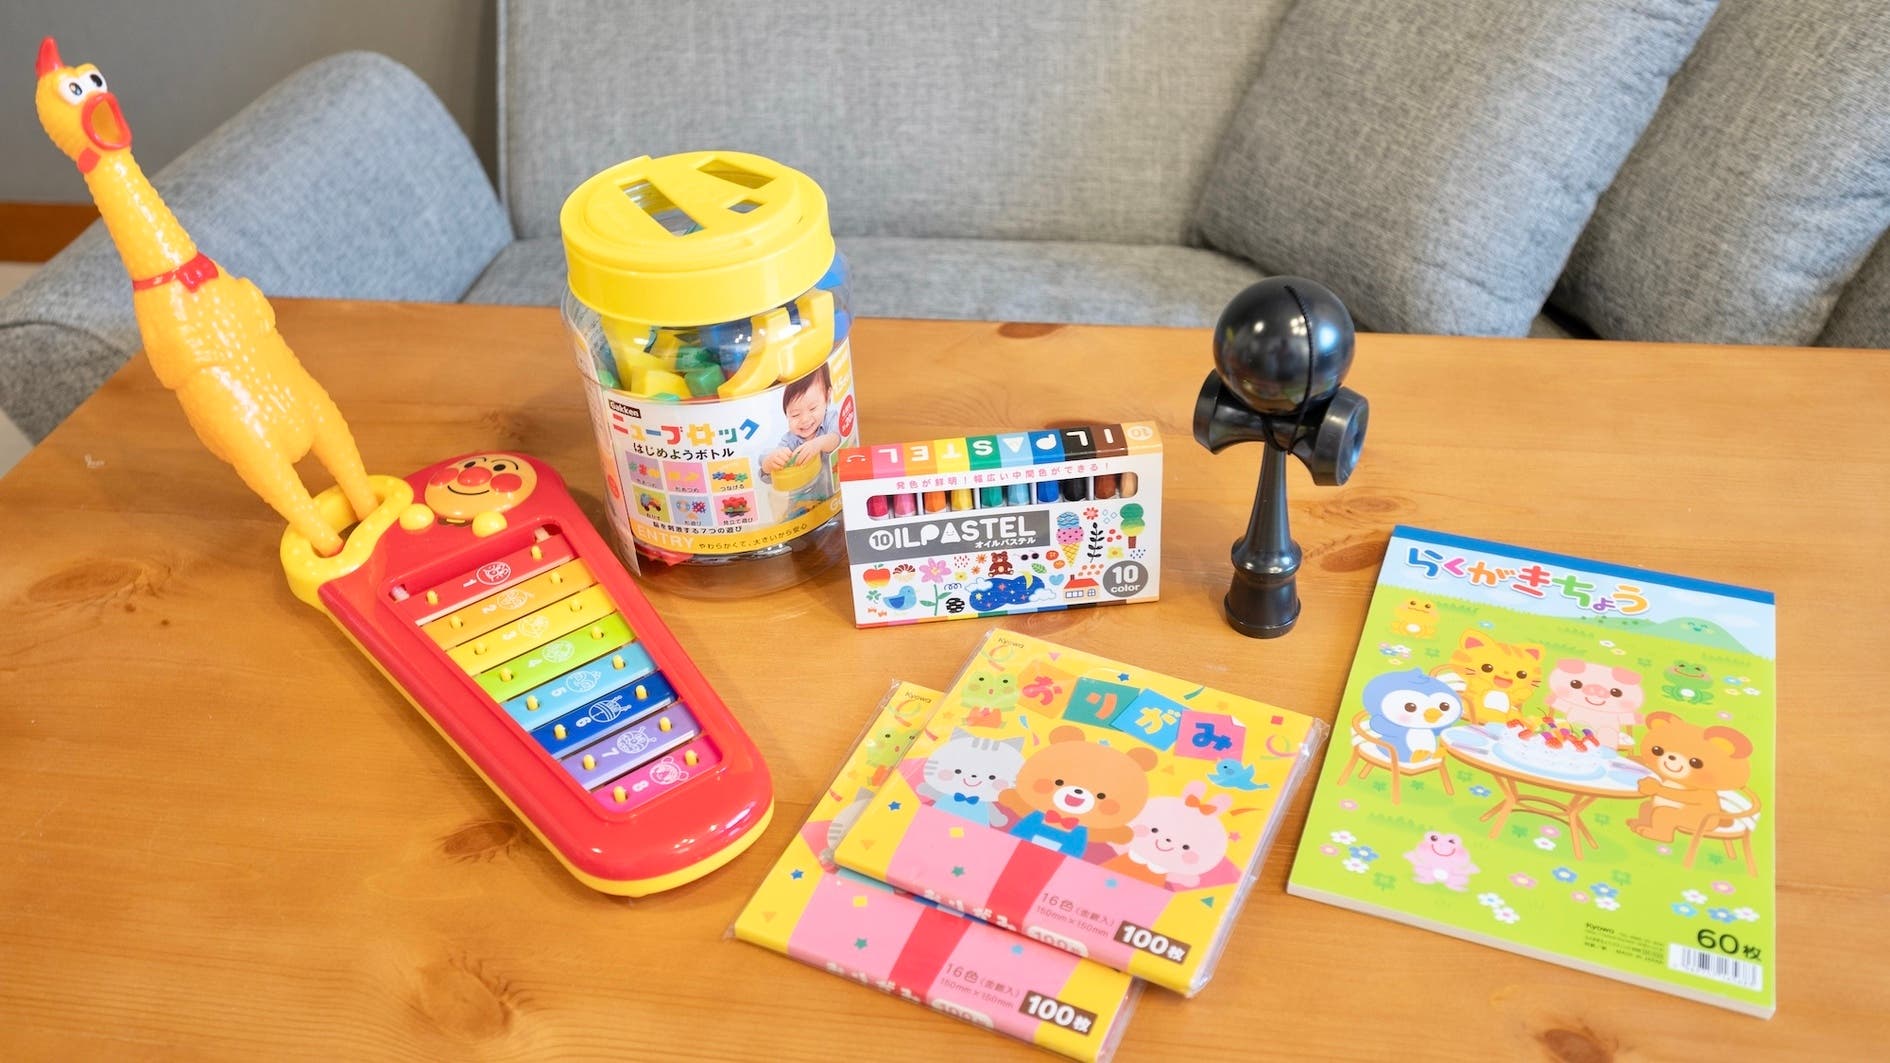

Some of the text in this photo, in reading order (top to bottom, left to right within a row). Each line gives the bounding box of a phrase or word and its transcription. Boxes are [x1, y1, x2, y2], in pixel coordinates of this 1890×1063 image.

[612, 413, 760, 447] ニューブロック
[633, 442, 735, 461] はじめようボトル
[638, 523, 695, 549] ENTRY
[975, 536, 1037, 549] オイルパステル
[1110, 582, 1141, 593] color
[1111, 565, 1140, 584] 10
[1408, 547, 1649, 614] らくがきちょう
[1022, 675, 1233, 751] おりがみ
[632, 780, 650, 793] 8
[1122, 924, 1187, 962] 100枚
[1696, 928, 1762, 961] 60枚
[1028, 994, 1092, 1034] 100枚
